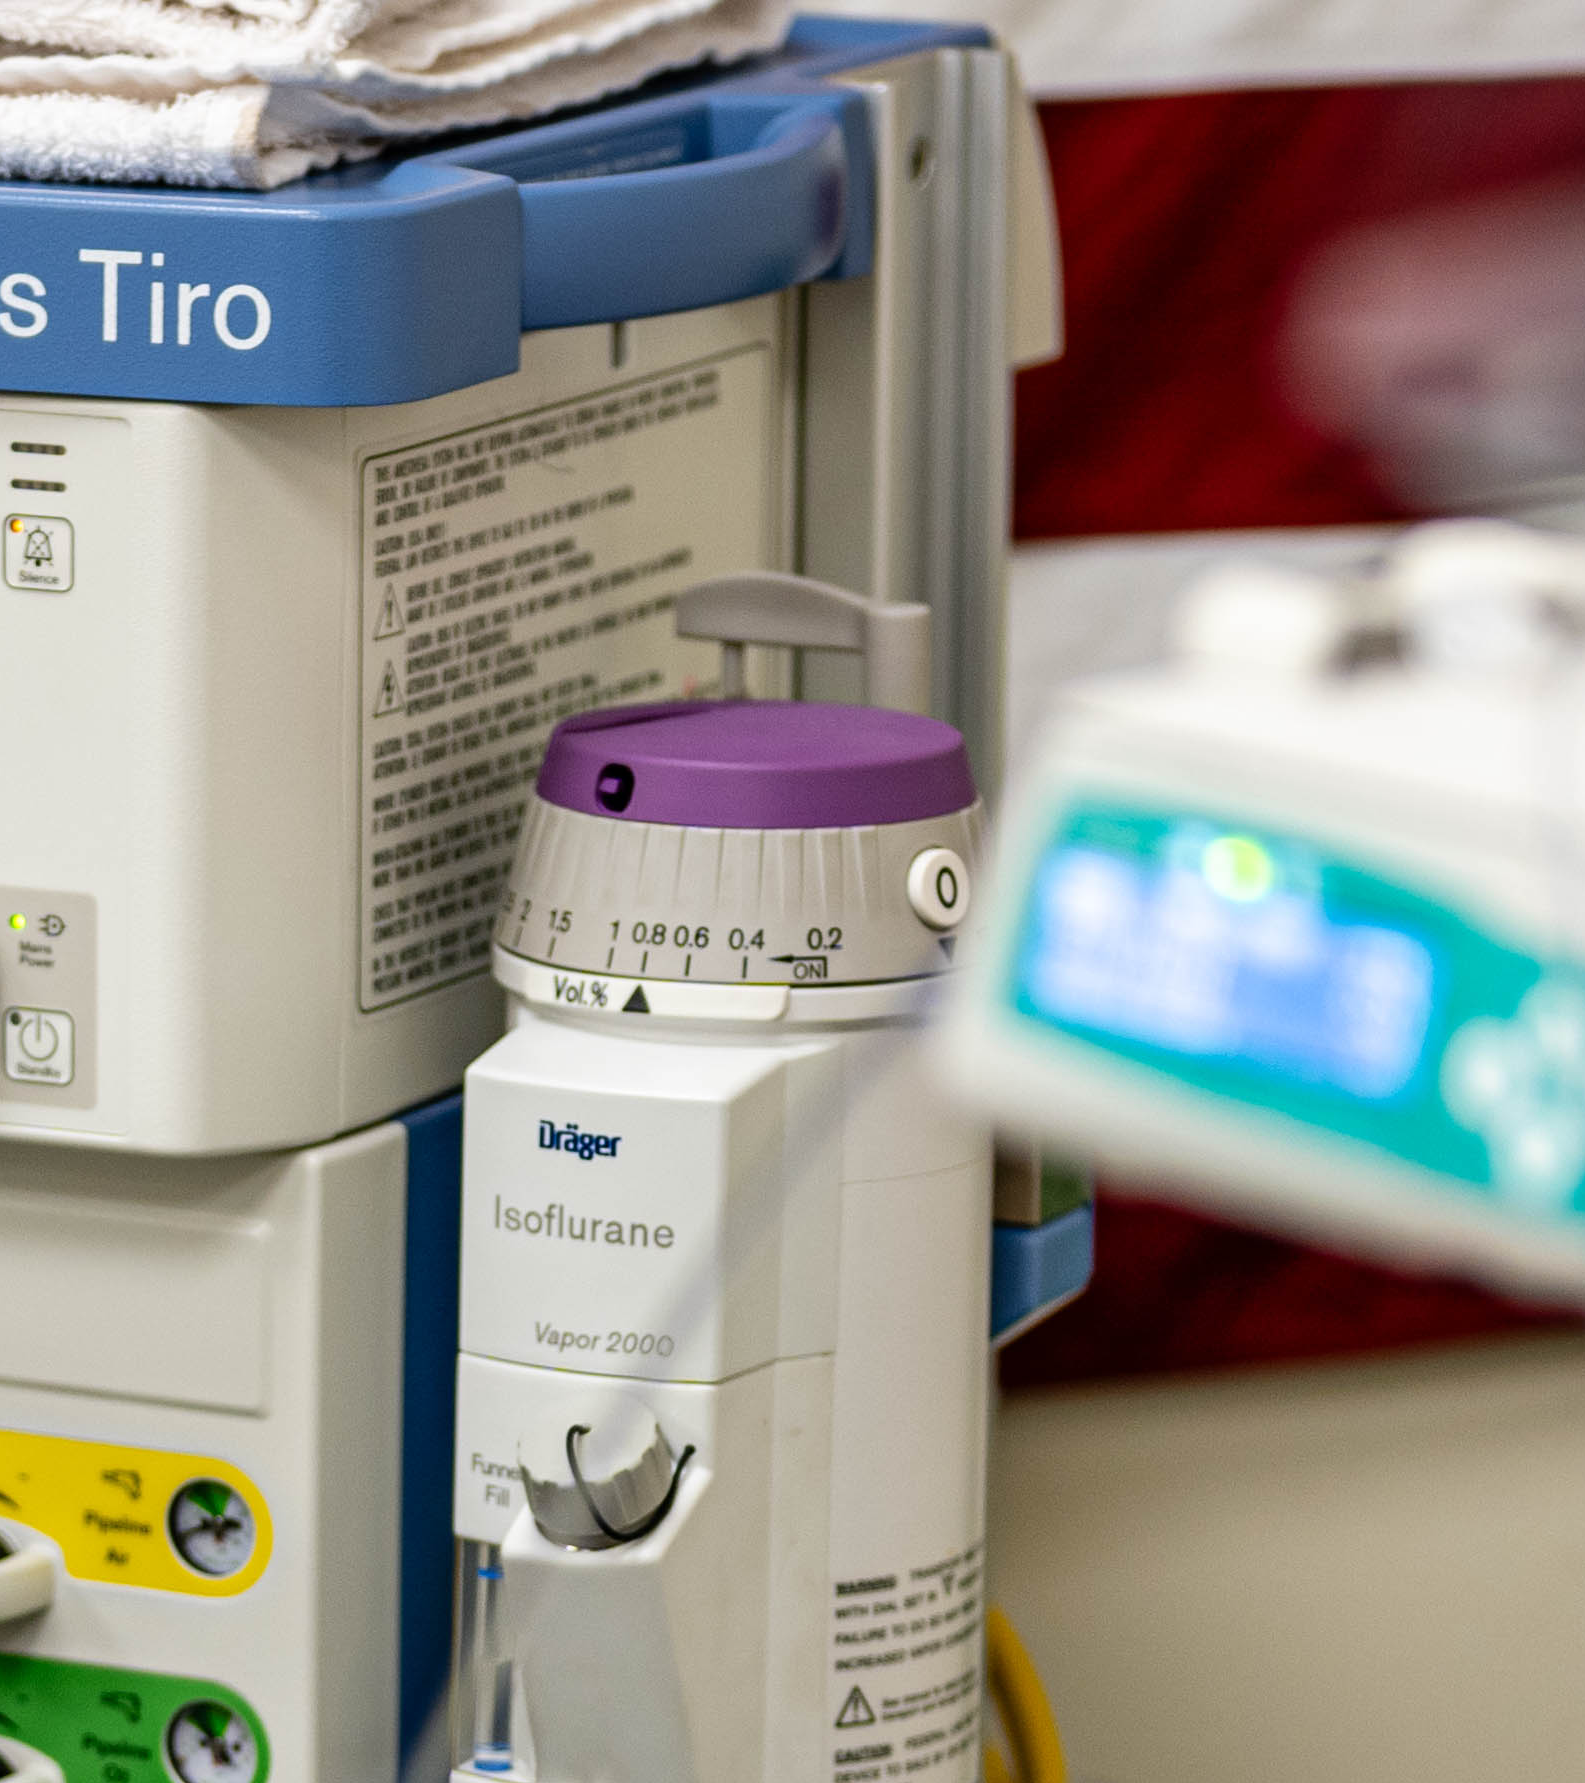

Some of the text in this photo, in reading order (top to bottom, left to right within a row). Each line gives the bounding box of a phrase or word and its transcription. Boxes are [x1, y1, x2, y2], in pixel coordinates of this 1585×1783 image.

[79, 249, 271, 350] Tiro
[19, 570, 60, 586] Silence
[936, 866, 959, 909] 0
[548, 909, 573, 934] 1.5
[610, 920, 622, 941] 1
[632, 922, 667, 947] 0.8
[673, 925, 710, 949] 0.6
[729, 928, 766, 951] 0.4
[806, 927, 843, 951] 0.2
[793, 962, 822, 980] ON
[538, 1120, 622, 1161] Dräger
[494, 1195, 676, 1249] Isoflurane
[533, 1321, 676, 1358] Vapor 2000
[471, 1453, 523, 1481] Funne
[485, 1484, 511, 1508] Fill
[83, 1508, 152, 1536] Pipeline
